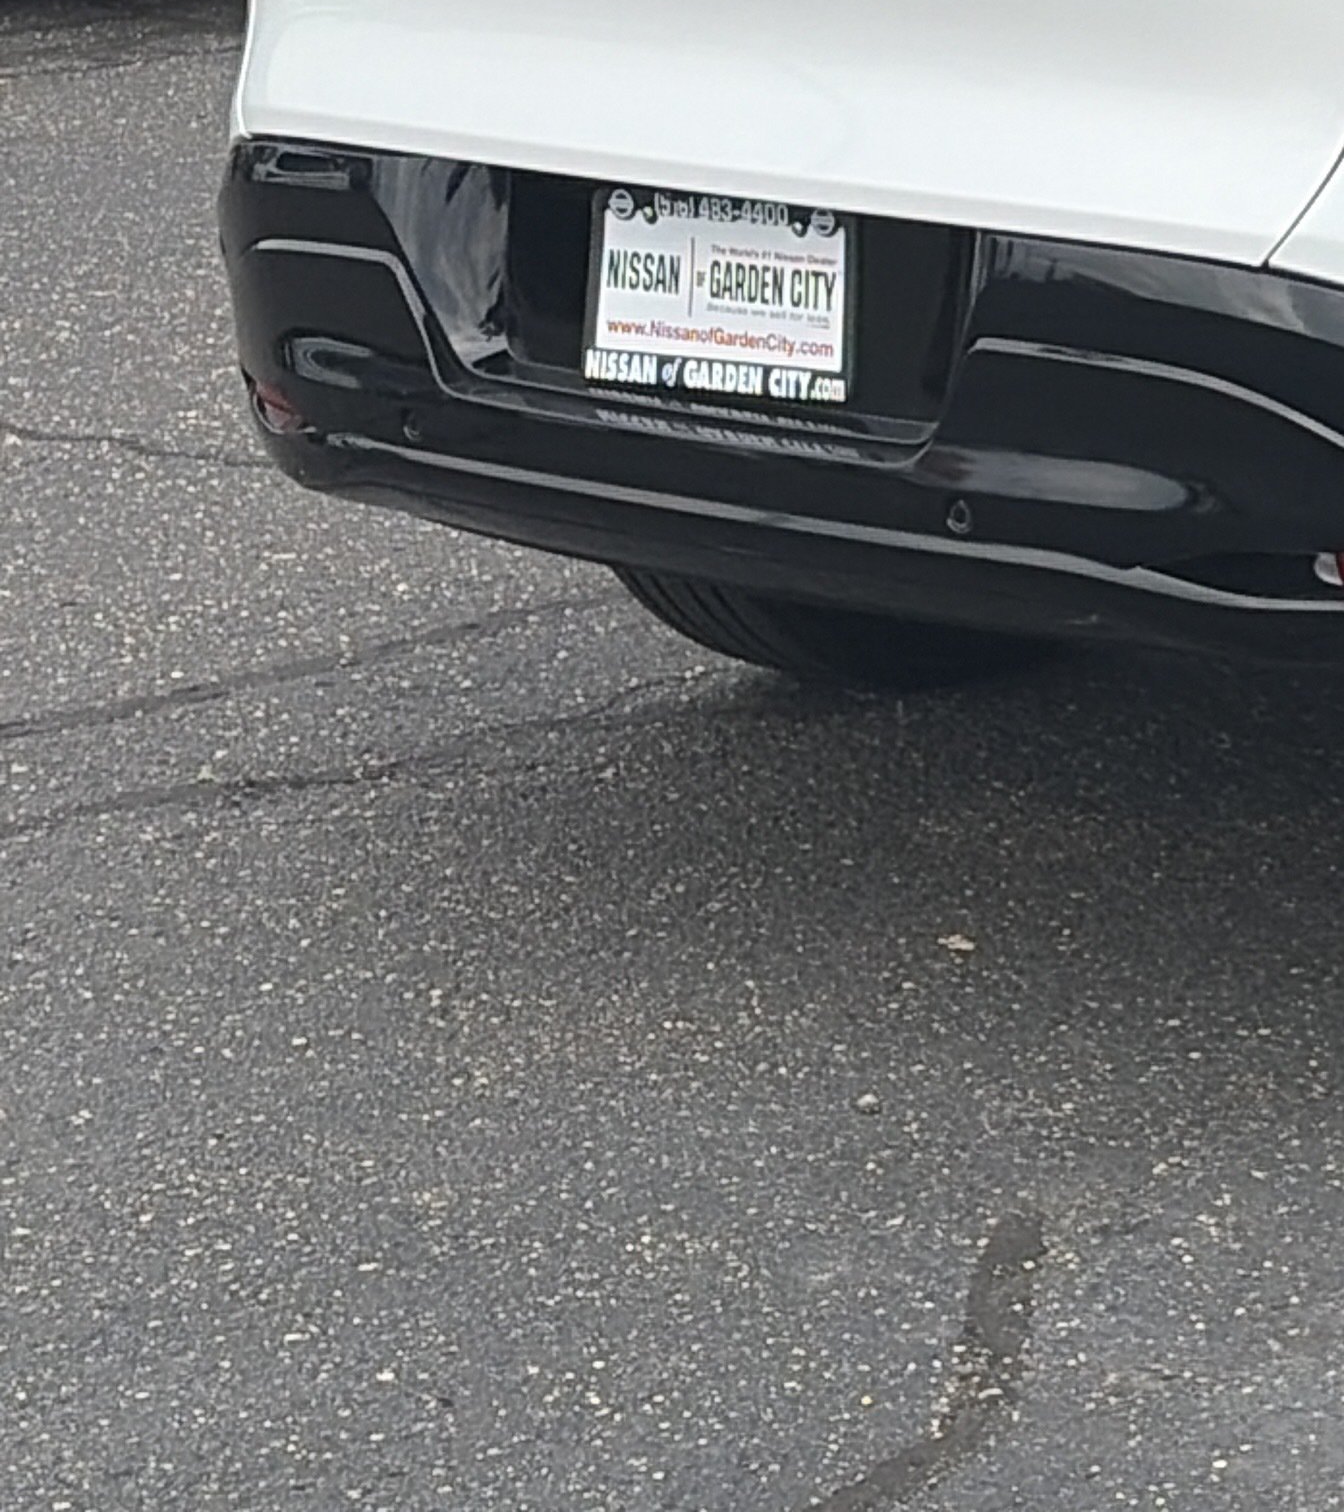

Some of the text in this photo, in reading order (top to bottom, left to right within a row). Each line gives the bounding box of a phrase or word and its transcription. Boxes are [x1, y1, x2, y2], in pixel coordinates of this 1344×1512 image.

[699, 196, 789, 226] 483-4400
[606, 248, 681, 295] NISSAN
[710, 260, 785, 308] GARDEN
[790, 268, 838, 312] CITY
[607, 318, 834, 357] www.NissanofGardenCity.com
[584, 348, 847, 402] NISSAN of GARDEN CITY.com
